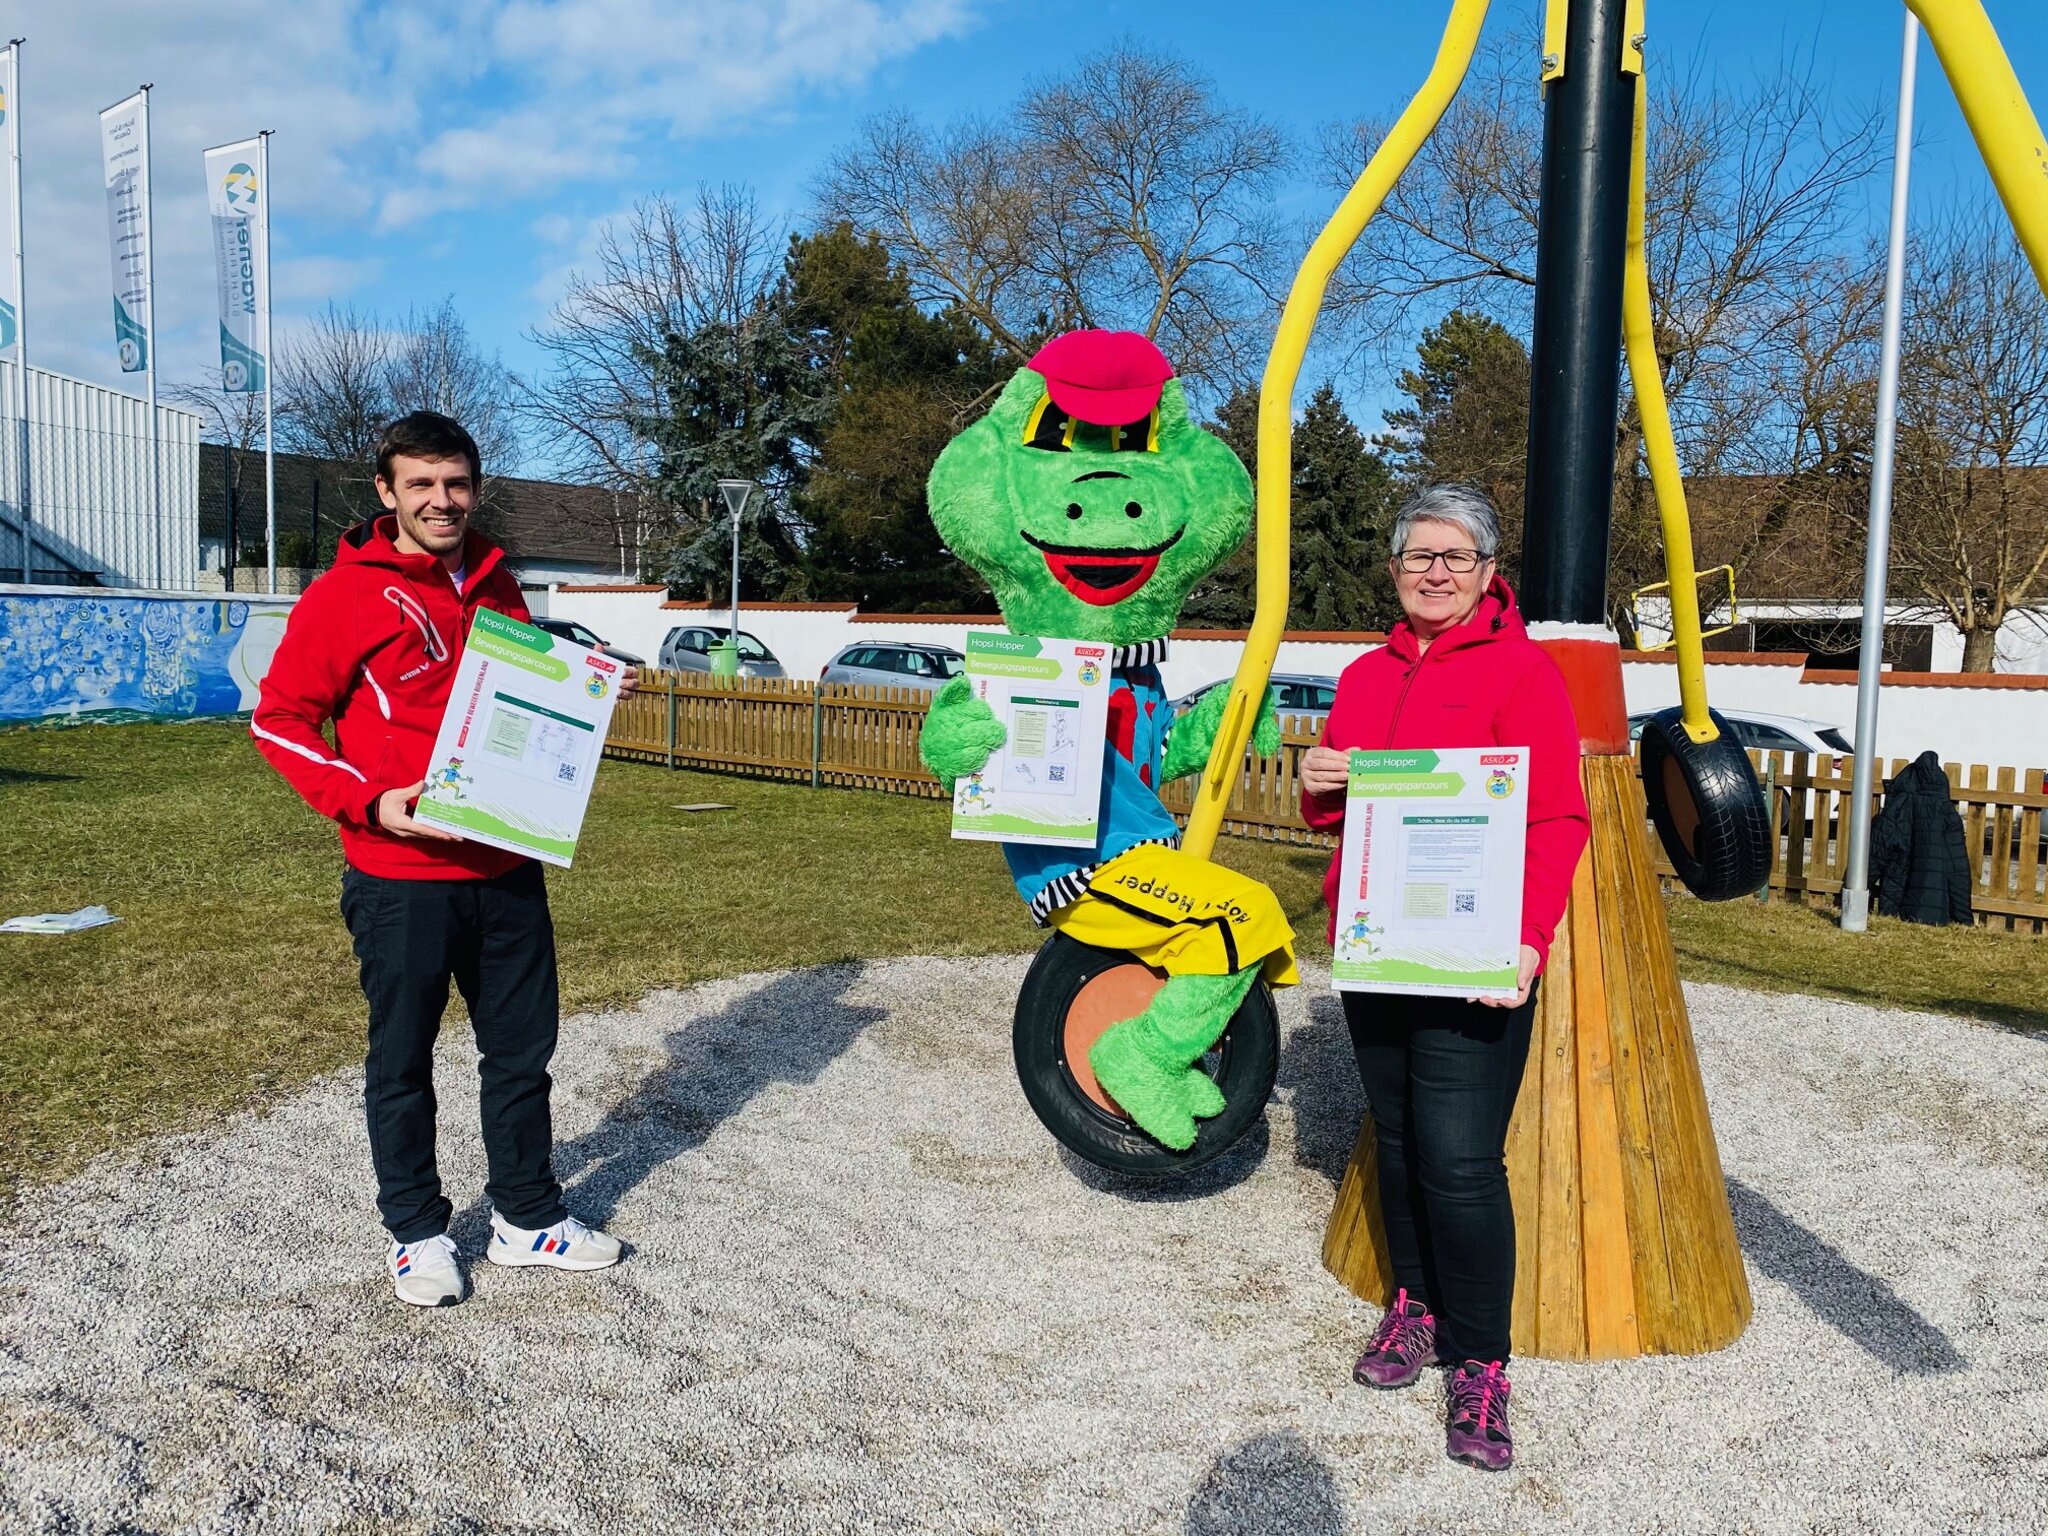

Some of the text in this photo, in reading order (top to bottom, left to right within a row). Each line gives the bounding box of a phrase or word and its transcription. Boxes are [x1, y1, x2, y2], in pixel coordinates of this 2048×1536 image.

[480, 614, 537, 643] Hopsi Hopper
[474, 636, 557, 674] Bewegungsparcours
[971, 638, 1025, 651] Hopsi Hopper
[474, 660, 489, 693] BURGENLAND
[970, 659, 1049, 674] Bewegungsparcours
[1354, 758, 1419, 768] Hopsi Hopper
[1354, 781, 1449, 792] Bewegungsparcours
[1364, 803, 1374, 838] BURGENLAND
[1114, 875, 1196, 914] Hopper
